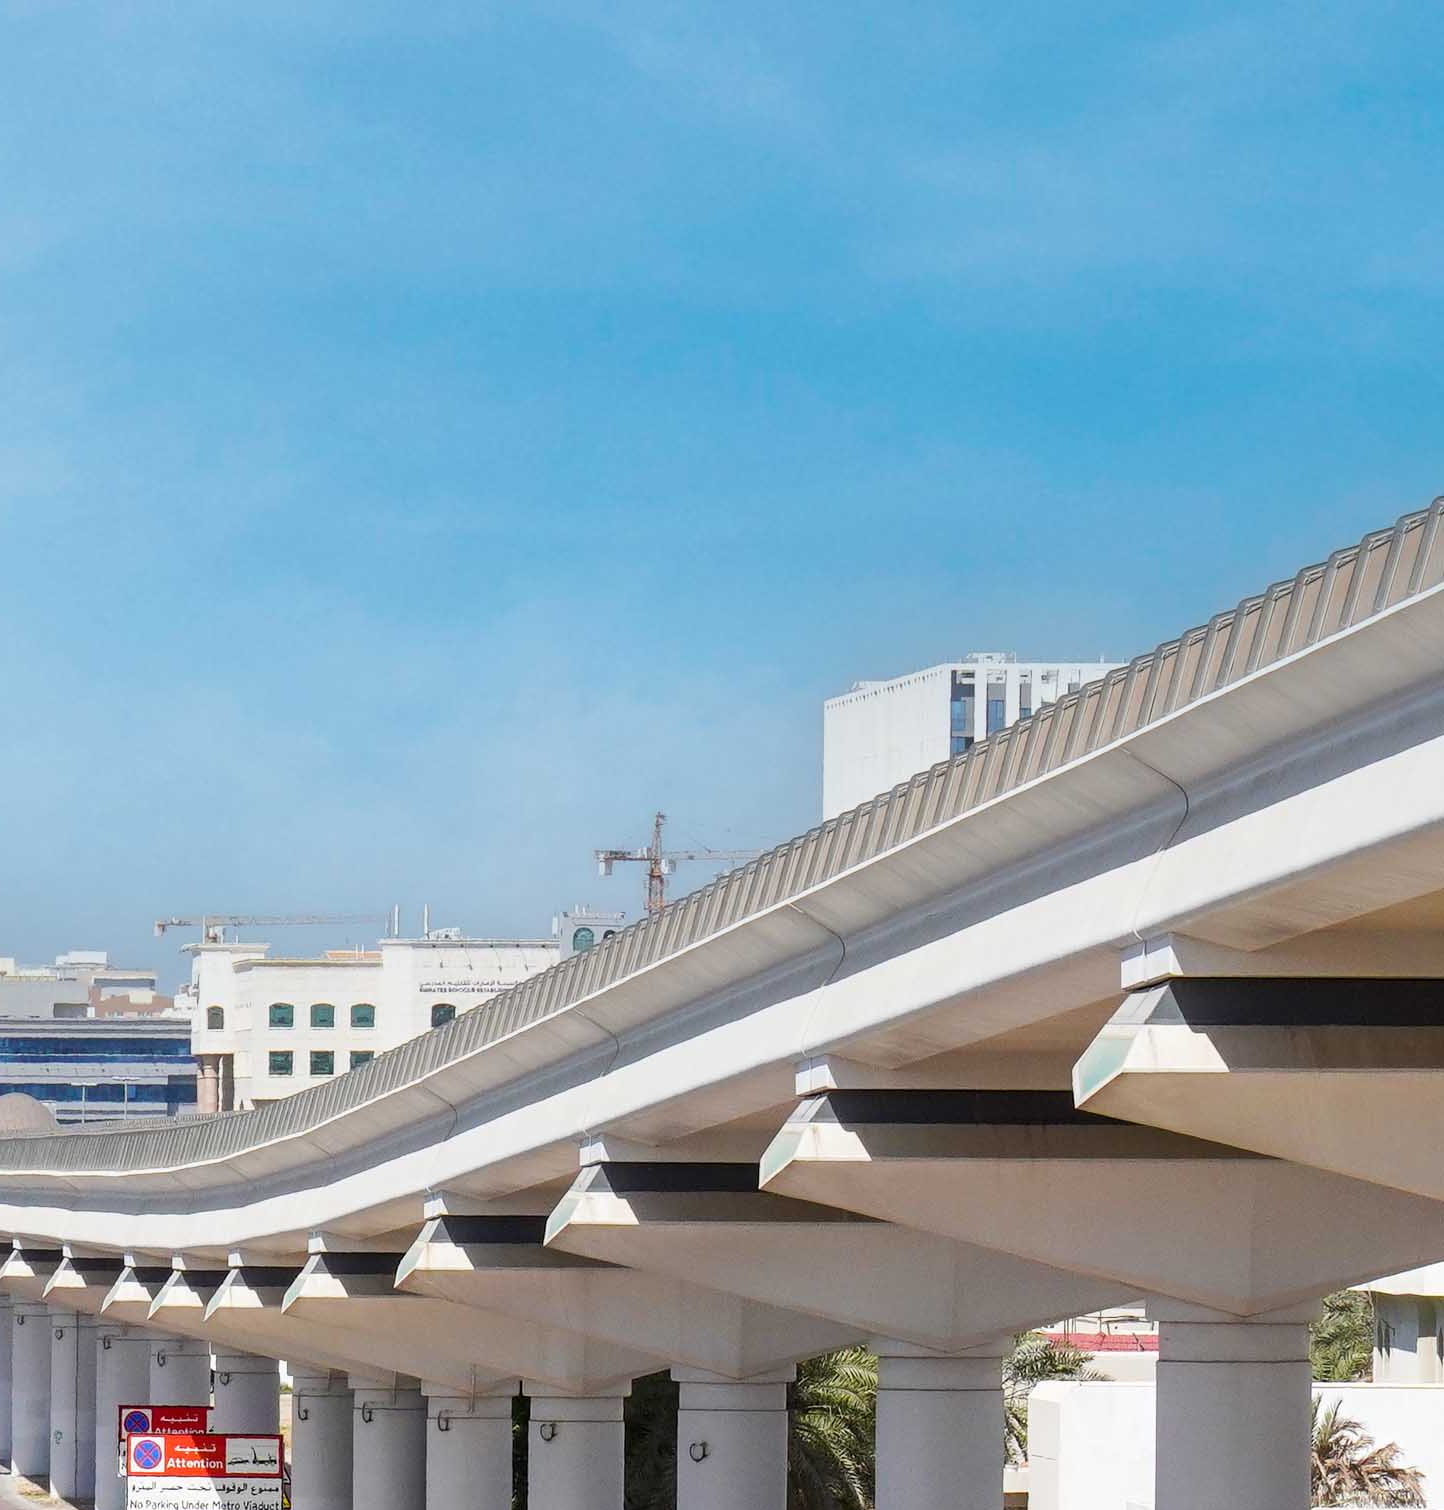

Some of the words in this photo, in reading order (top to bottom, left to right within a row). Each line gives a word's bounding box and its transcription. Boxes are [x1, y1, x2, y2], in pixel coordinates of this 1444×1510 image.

[167, 1457, 224, 1469] Attention
[129, 1500, 144, 1510] No
[181, 1500, 209, 1510] Under
[212, 1501, 241, 1510] Metro
[243, 1500, 280, 1510] Viaduct
